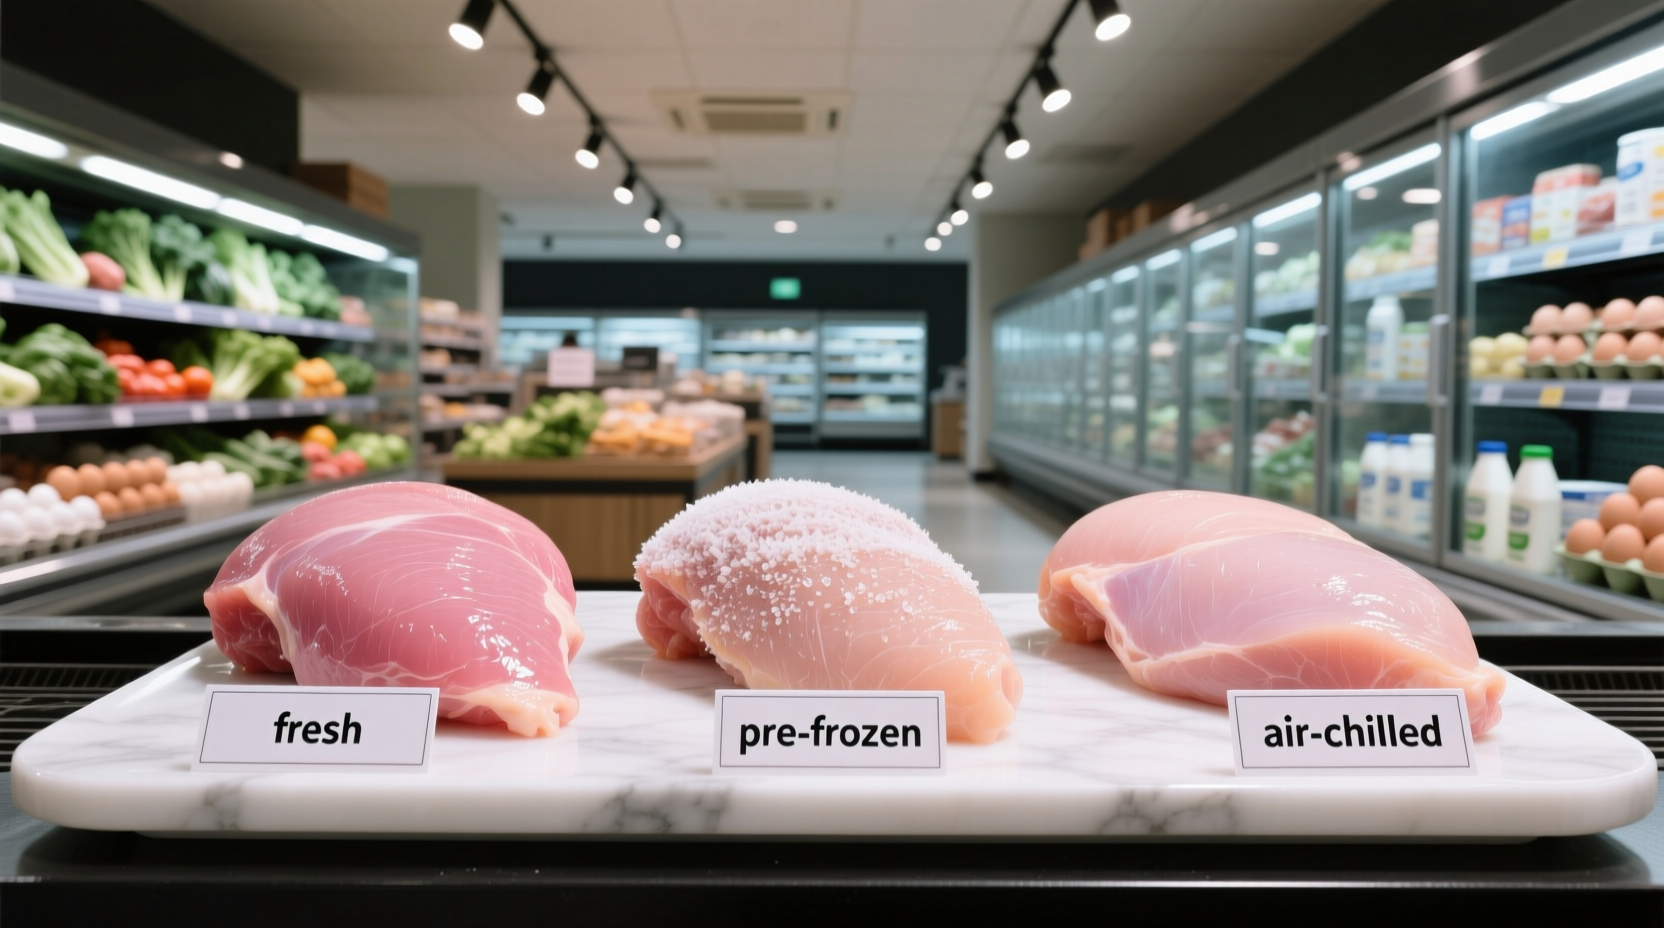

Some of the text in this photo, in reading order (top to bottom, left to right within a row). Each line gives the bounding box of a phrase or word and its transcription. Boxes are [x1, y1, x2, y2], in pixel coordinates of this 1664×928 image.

[273, 710, 362, 745] fresh
[739, 714, 922, 755] pre-frozen
[1264, 714, 1443, 748] air-chilled
